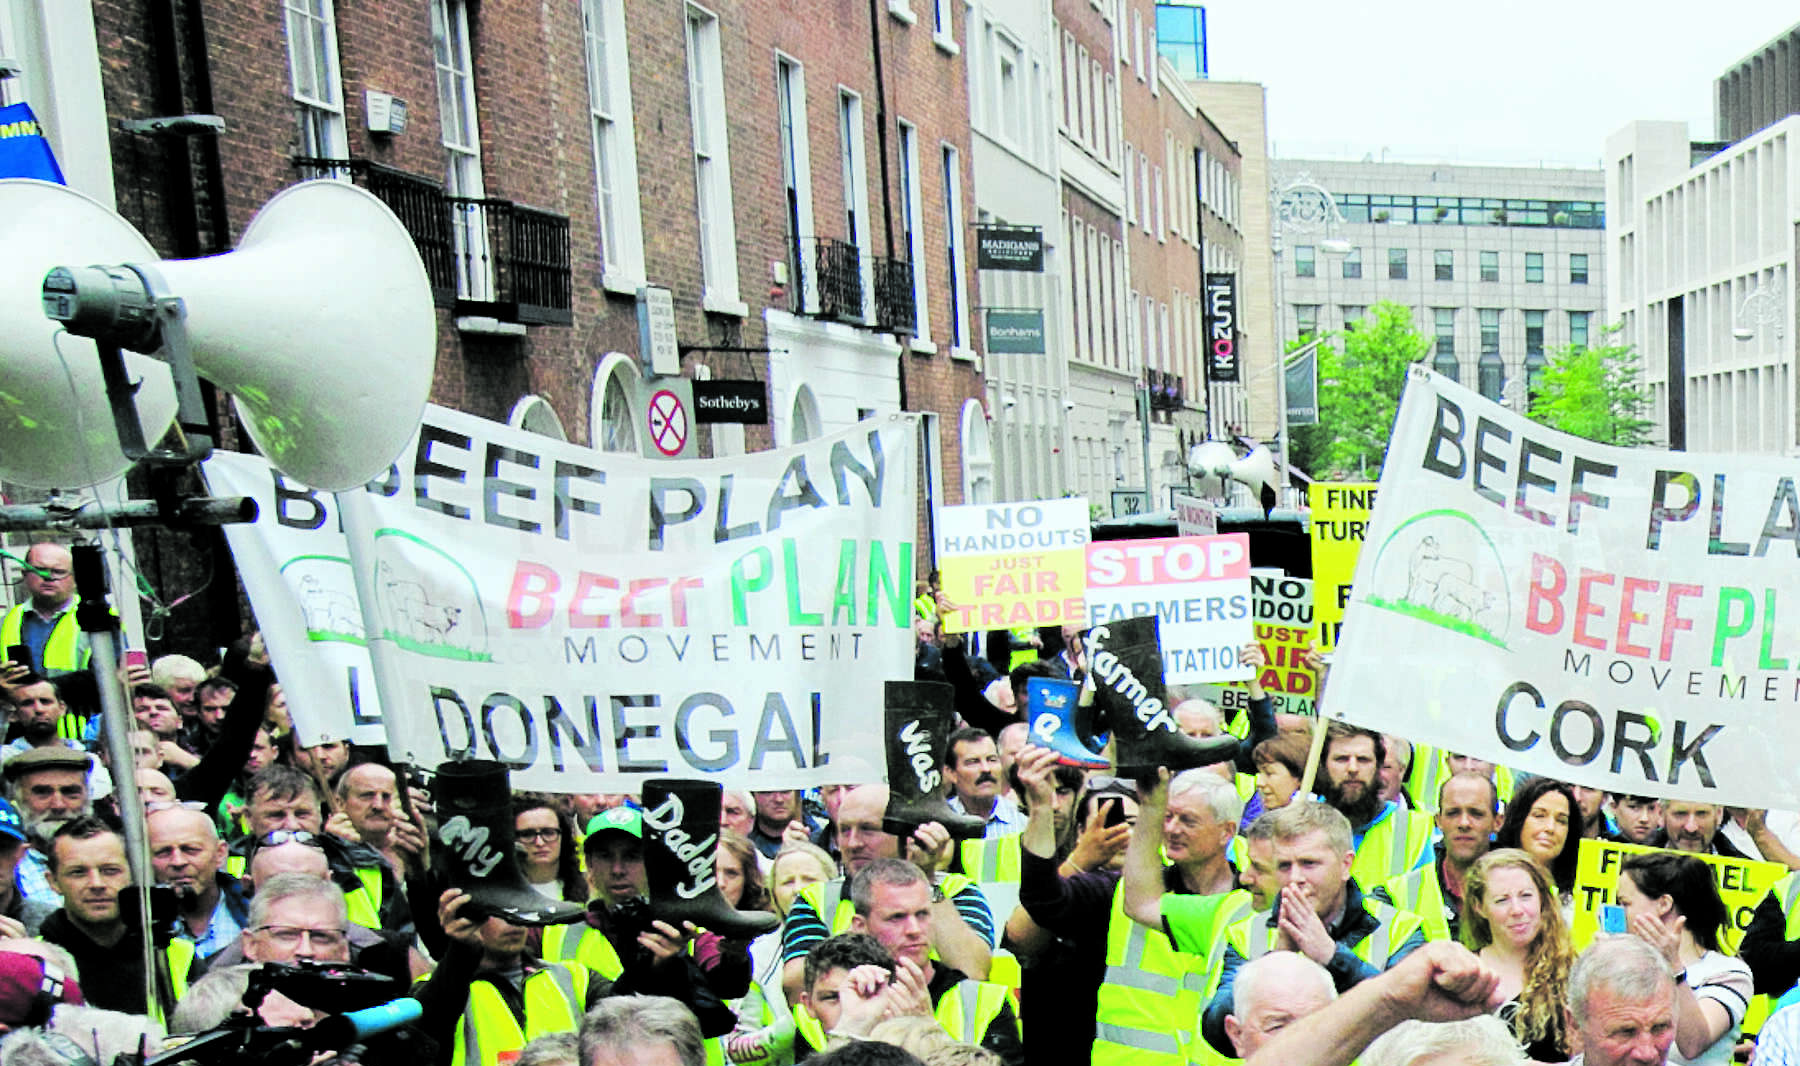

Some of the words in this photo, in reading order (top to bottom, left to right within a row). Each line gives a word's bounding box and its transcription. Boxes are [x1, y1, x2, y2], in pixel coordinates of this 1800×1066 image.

[990, 326, 1041, 337] Bonhams
[699, 395, 760, 412] Sotheby's
[1421, 393, 1618, 535] BEEF
[646, 430, 885, 551] PLAN
[986, 505, 1043, 531] NO
[944, 526, 1087, 554] HANDOUTS
[989, 554, 1045, 570] JUST
[1088, 539, 1244, 585] STOP
[730, 538, 913, 630] PLAN
[974, 570, 1061, 598] FAIR
[1251, 575, 1306, 599] NO
[956, 598, 1086, 628] TRADE
[1525, 552, 1704, 663] BEEF
[563, 632, 864, 664] MOVEMENT
[1255, 625, 1308, 643] UST
[1082, 625, 1178, 735] farmer
[430, 684, 830, 774] DONEGAL
[1495, 681, 1726, 790] CORK
[439, 815, 503, 878] My
[643, 792, 718, 900] Daddy
